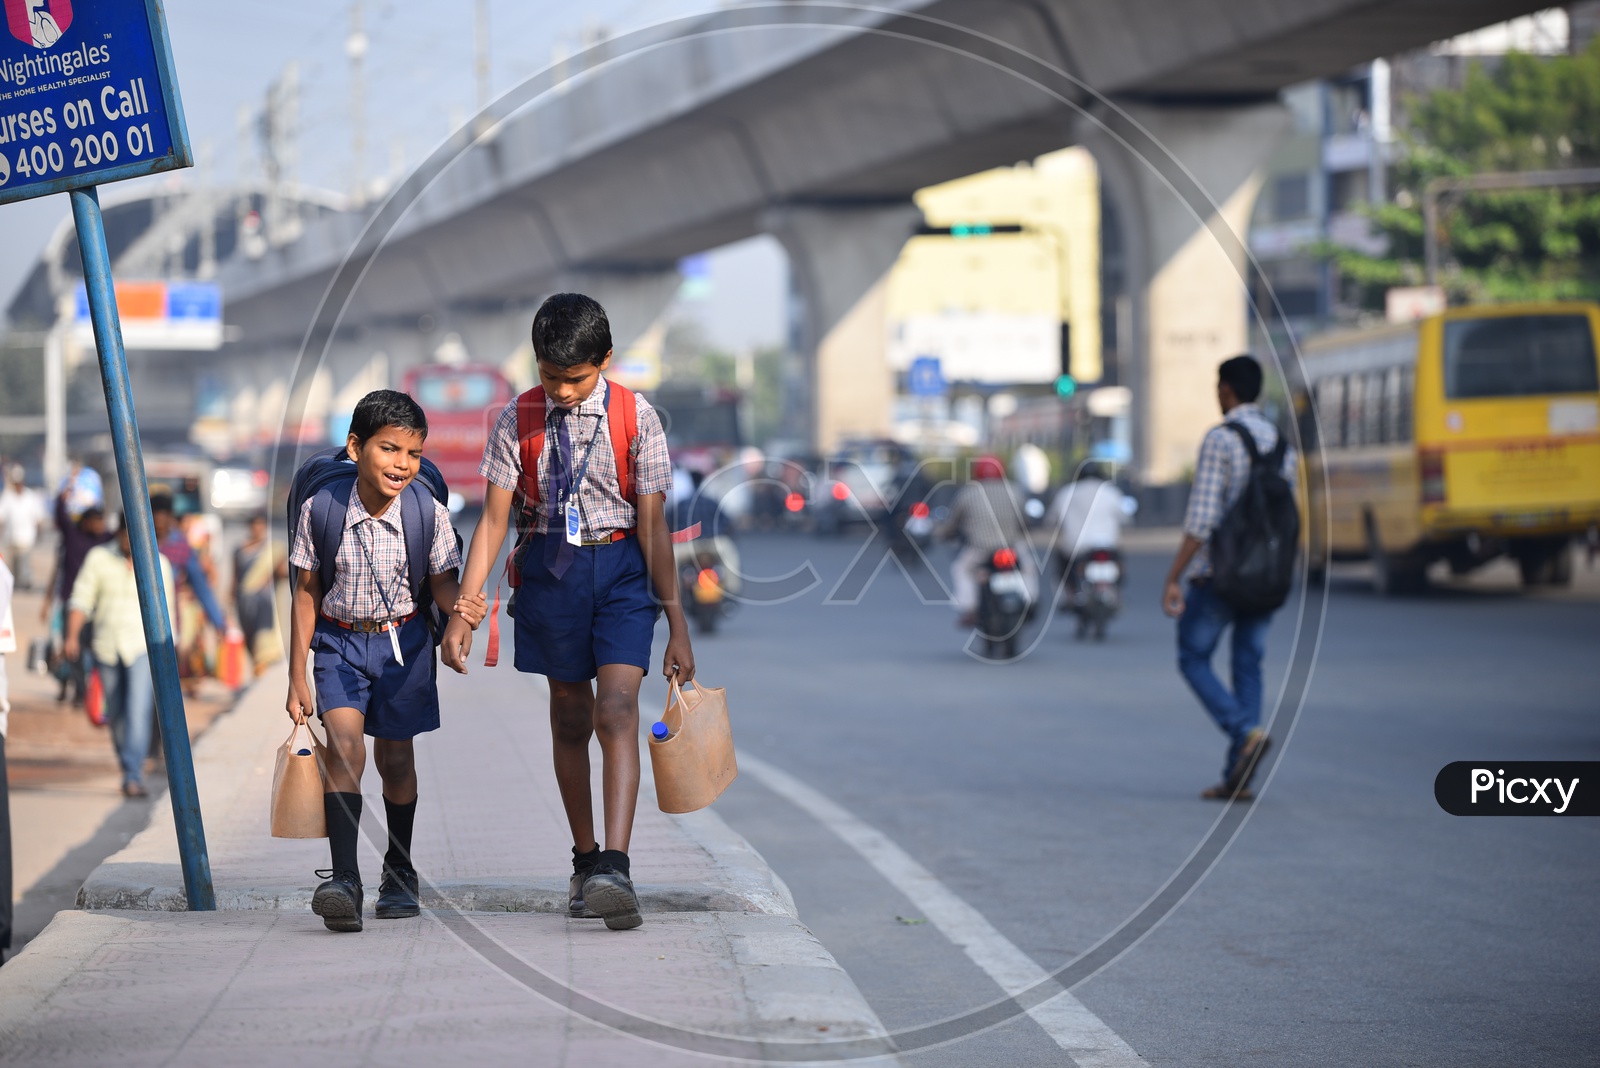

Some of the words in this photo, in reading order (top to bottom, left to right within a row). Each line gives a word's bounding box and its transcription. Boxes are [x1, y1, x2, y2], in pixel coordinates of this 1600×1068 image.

[0, 41, 110, 85] Nightingales
[14, 87, 36, 97] HOME
[38, 81, 67, 92] HEALTH
[68, 71, 111, 86] SPECIALIST
[63, 98, 95, 130] on
[101, 77, 149, 121] Call
[16, 142, 64, 178] 400
[70, 131, 119, 168] 200
[127, 123, 154, 156] 01
